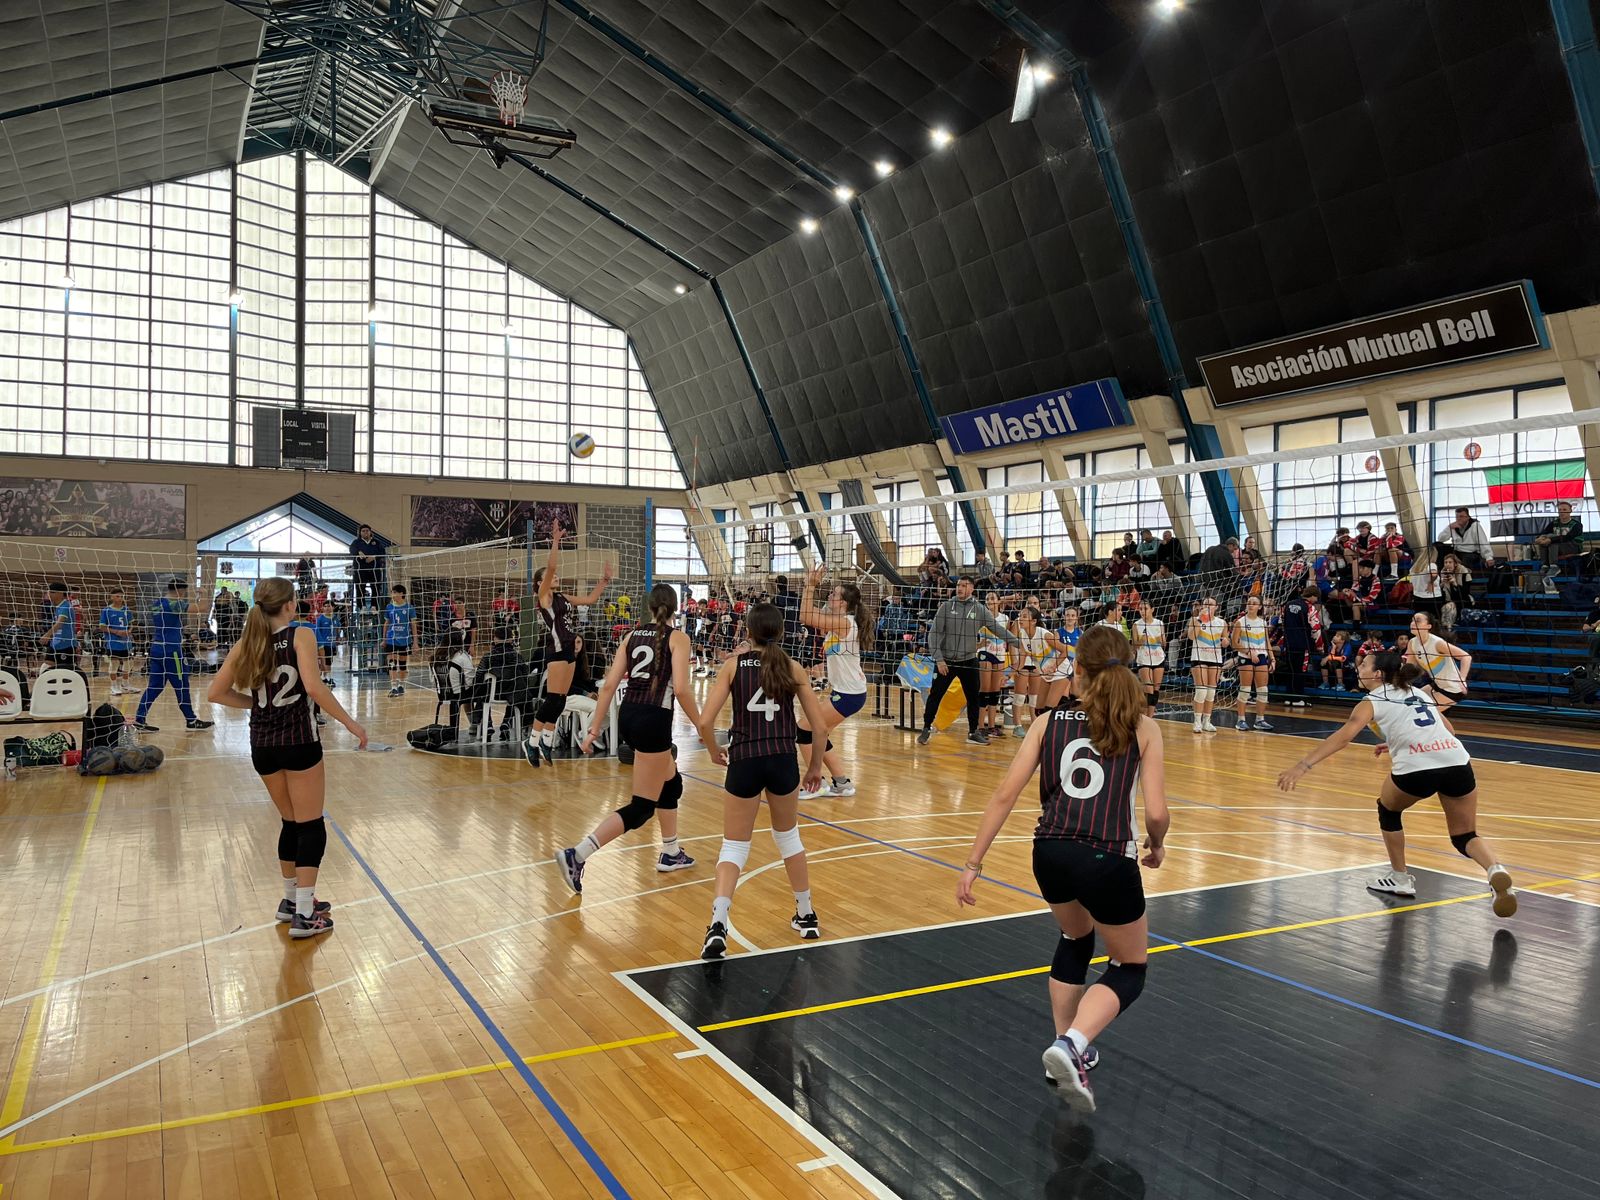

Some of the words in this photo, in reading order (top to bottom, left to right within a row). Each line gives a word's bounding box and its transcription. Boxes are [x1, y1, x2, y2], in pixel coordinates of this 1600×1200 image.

[1230, 344, 1348, 389] Asociación
[1347, 322, 1437, 365] Mutual
[1436, 309, 1496, 347] Bell
[283, 420, 299, 428] LOCAL
[311, 421, 326, 429] VISITA
[974, 395, 1078, 448] Mastil
[1514, 501, 1559, 514] VOLEY
[633, 630, 666, 638] REGAT
[631, 645, 654, 679] 2
[740, 659, 761, 668] REG
[746, 686, 781, 722] 4
[1054, 710, 1089, 721] REG
[1404, 695, 1436, 728] 3
[1059, 737, 1105, 799] 6
